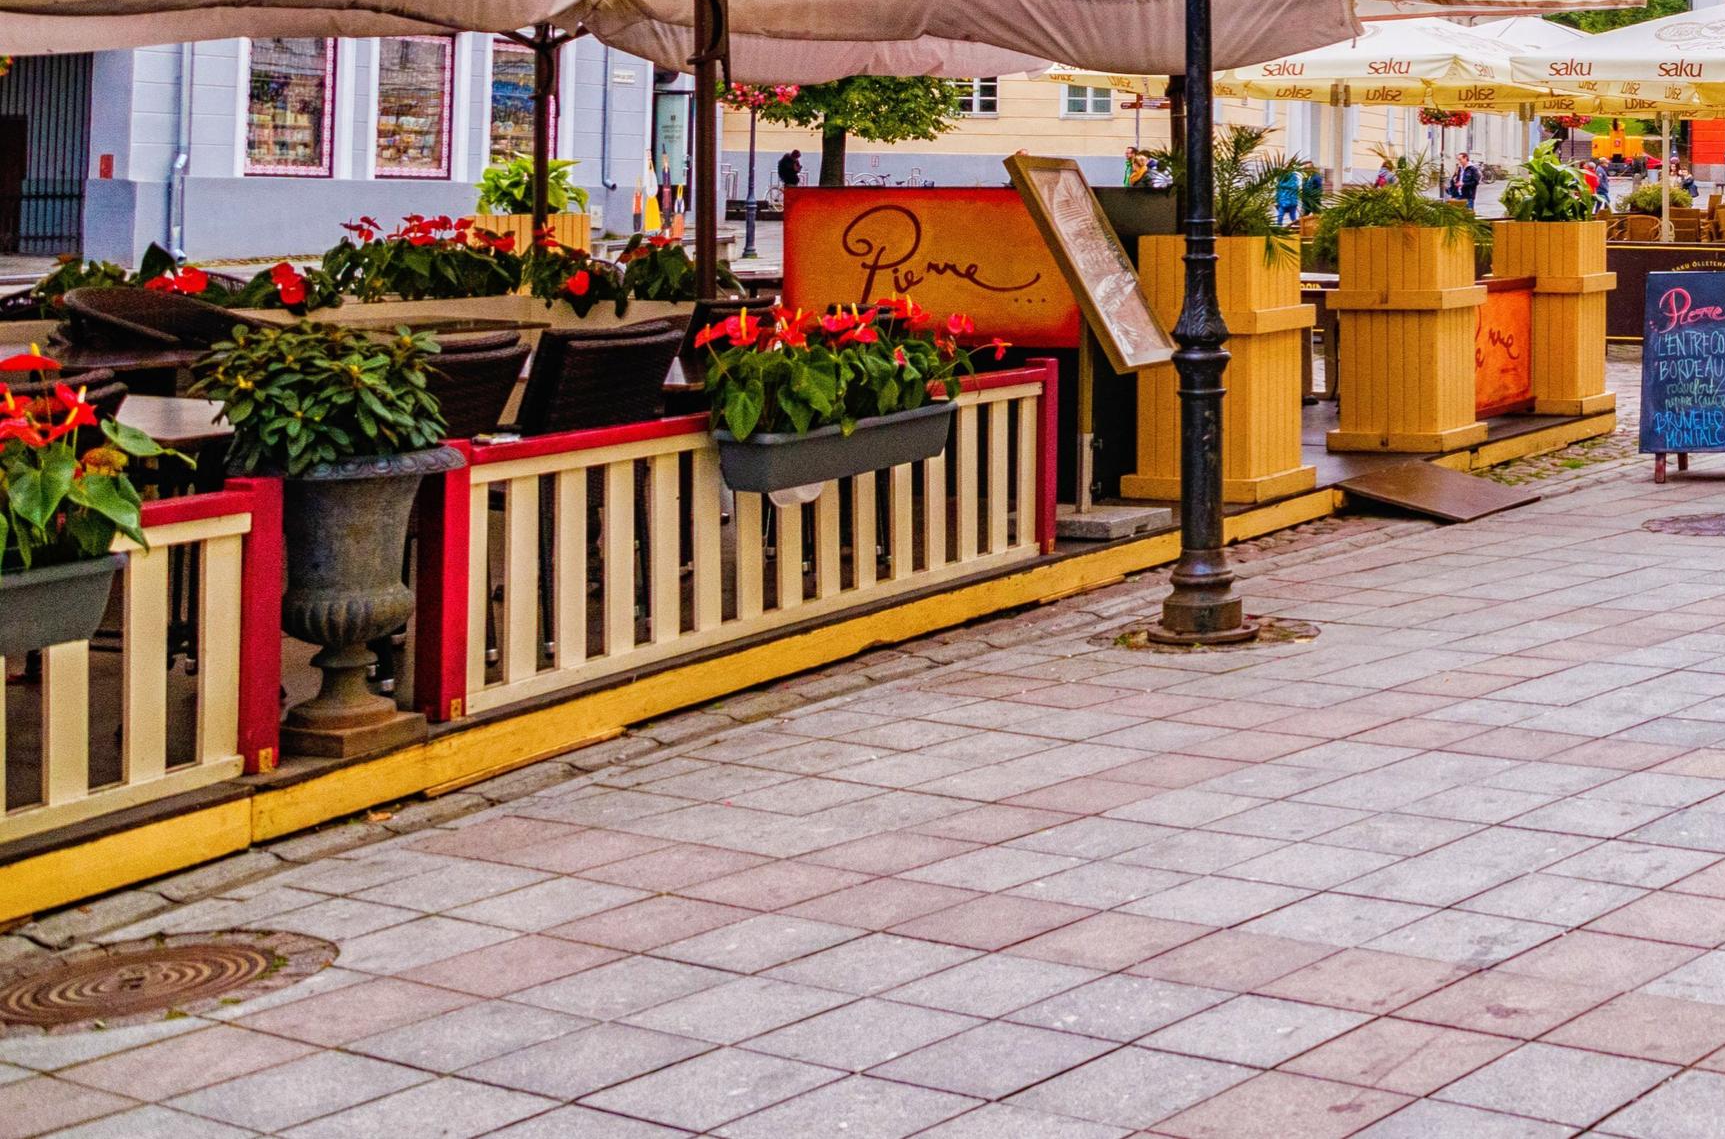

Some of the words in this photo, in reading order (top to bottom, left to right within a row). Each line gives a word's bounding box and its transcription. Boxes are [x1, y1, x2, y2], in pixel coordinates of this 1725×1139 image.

[1261, 59, 1304, 77] saku
[1366, 58, 1411, 76] saku
[1549, 58, 1592, 77] saku
[1658, 58, 1703, 78] saku
